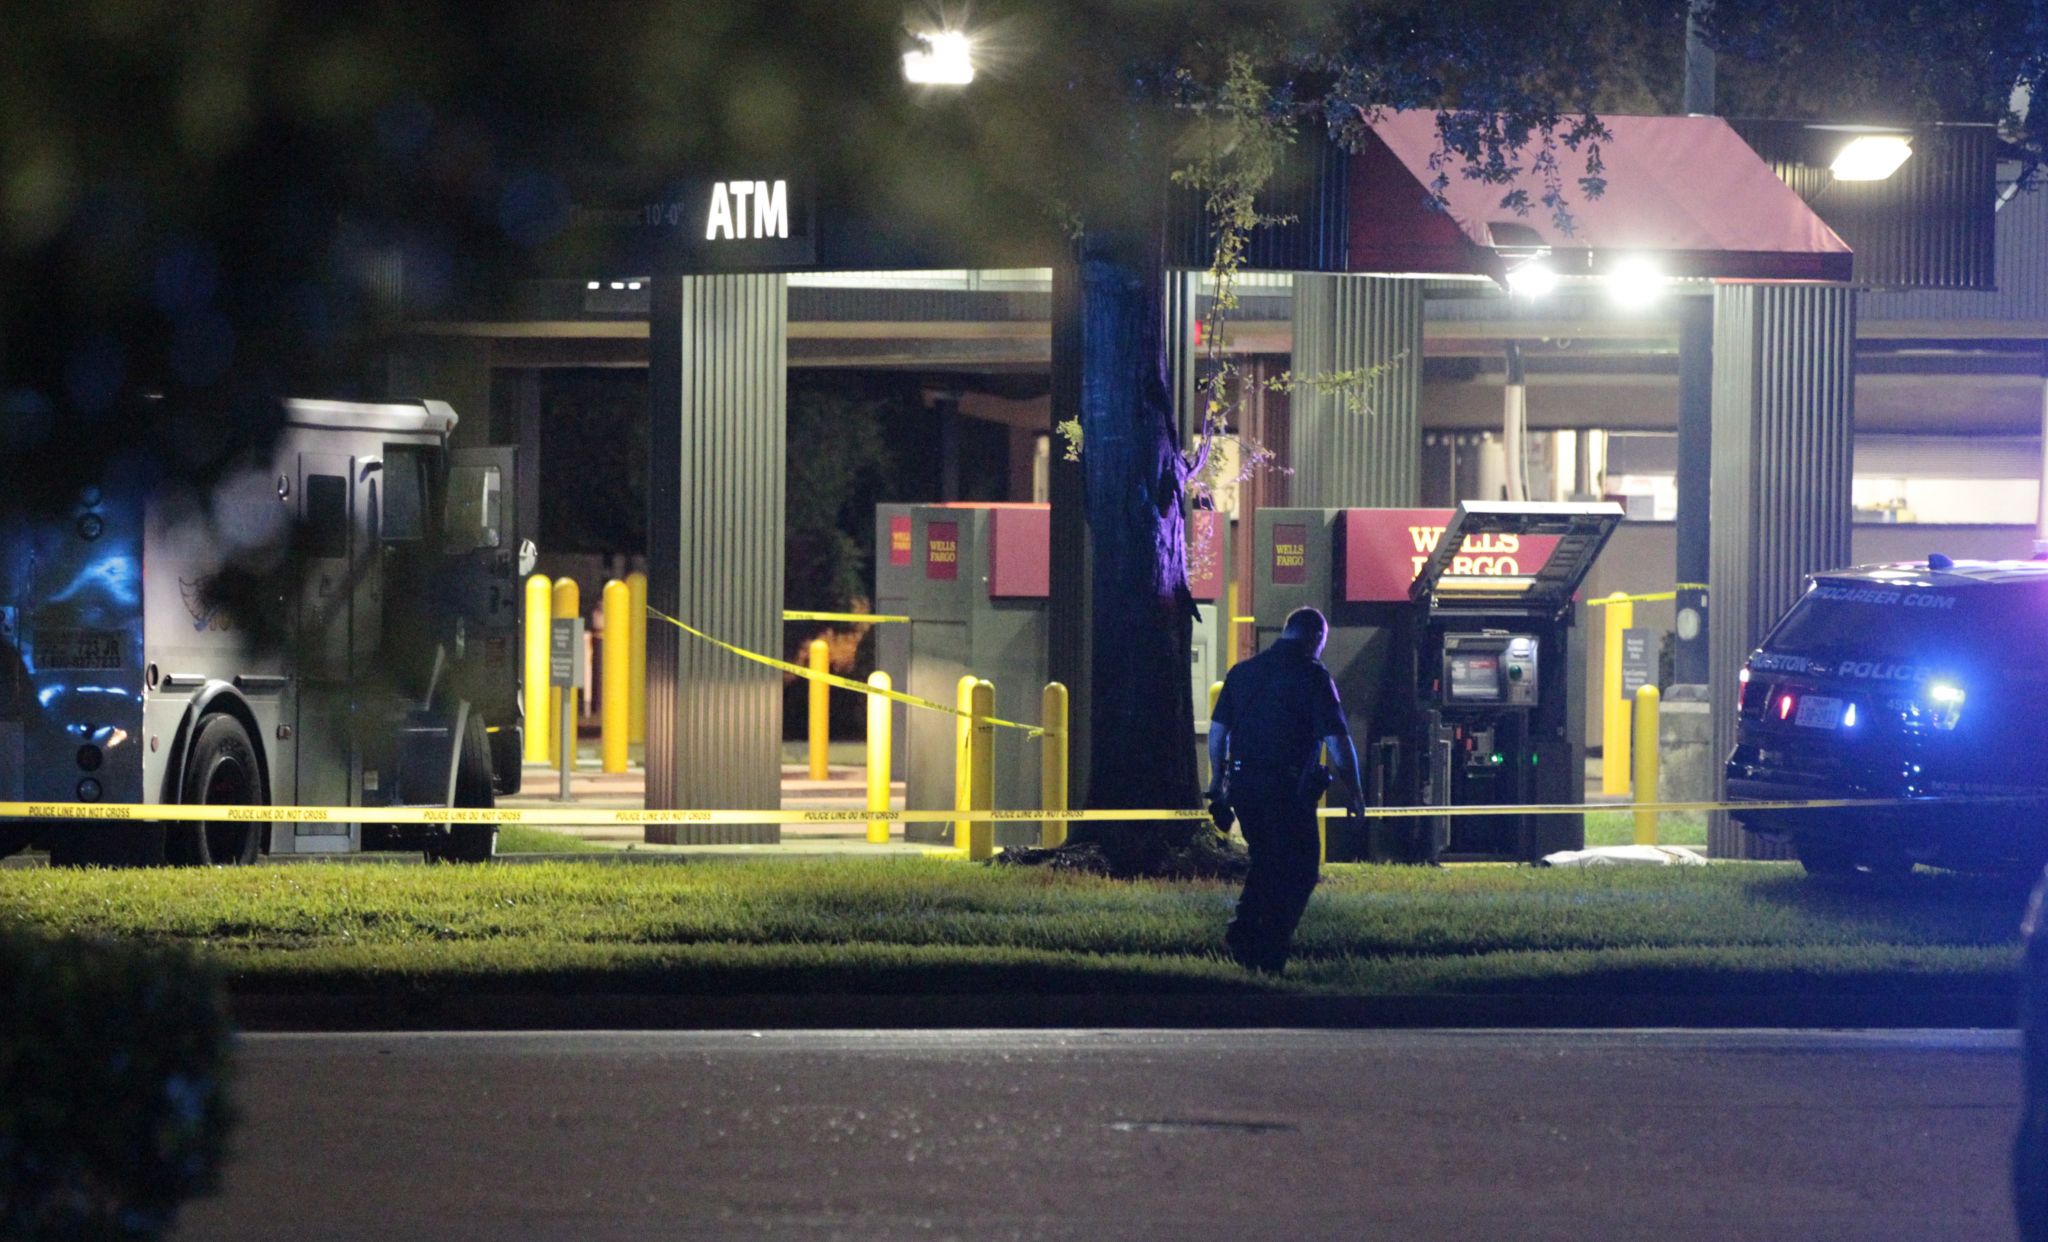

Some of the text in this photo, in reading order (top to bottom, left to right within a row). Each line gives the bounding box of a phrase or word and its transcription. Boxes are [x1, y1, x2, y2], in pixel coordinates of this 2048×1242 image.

[706, 180, 788, 241] ATM
[930, 541, 956, 550] WELLS
[1408, 526, 1520, 554] WLLS
[1276, 544, 1304, 554] WELLS
[930, 551, 956, 562] FARGO
[1276, 555, 1304, 566] FARGO
[1411, 556, 1519, 582] FRGO
[1838, 660, 1930, 685] POLICE
[28, 806, 130, 818] POLICE LINE DO NOT CROSS
[228, 809, 327, 820] POLICE LINE DO NOT CROSS
[424, 811, 521, 821] POLICE LINE DO NOT CROSS
[616, 812, 711, 821] POLICE LINE DO NOT CROSS
[804, 811, 899, 820] POLICE LINE DO NOT CROSS
[1061, 810, 1084, 818] CROSS
